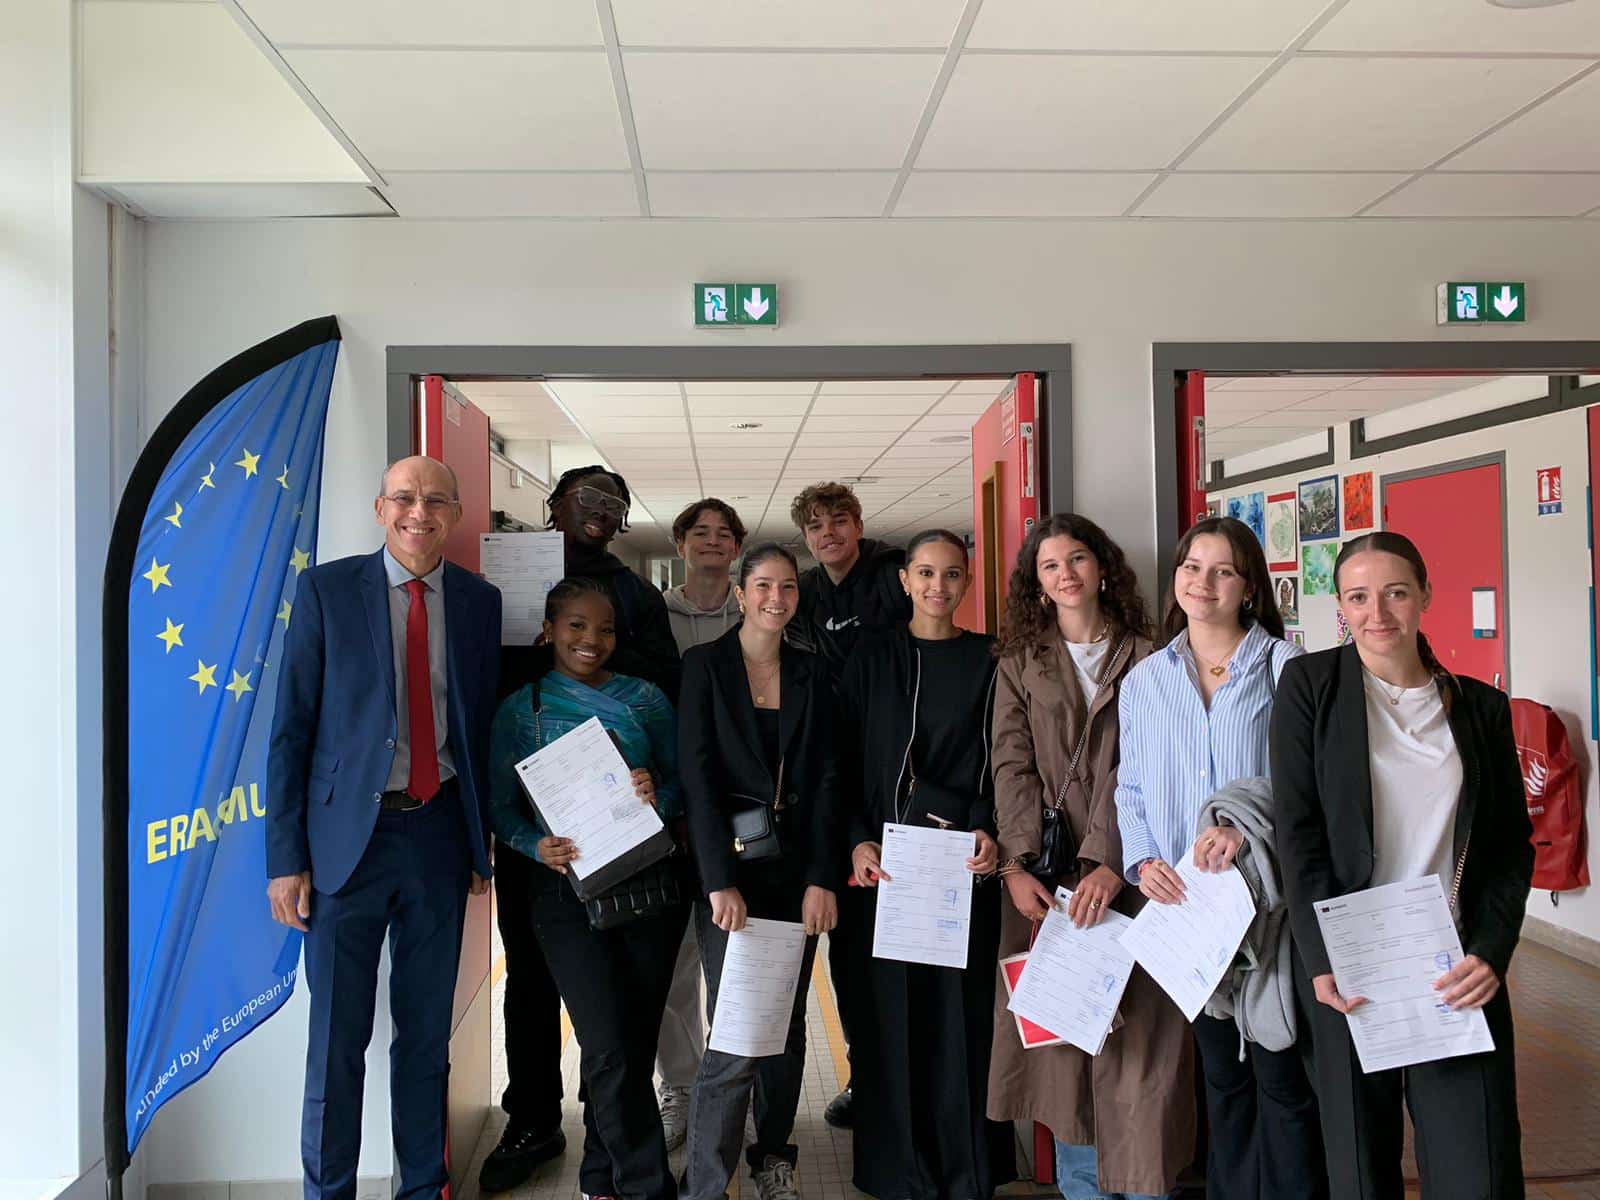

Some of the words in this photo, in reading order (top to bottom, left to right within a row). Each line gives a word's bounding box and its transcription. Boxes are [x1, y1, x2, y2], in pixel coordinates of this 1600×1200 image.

[180, 1046, 200, 1068] by
[202, 1027, 219, 1051] the
[222, 983, 281, 1032] European
